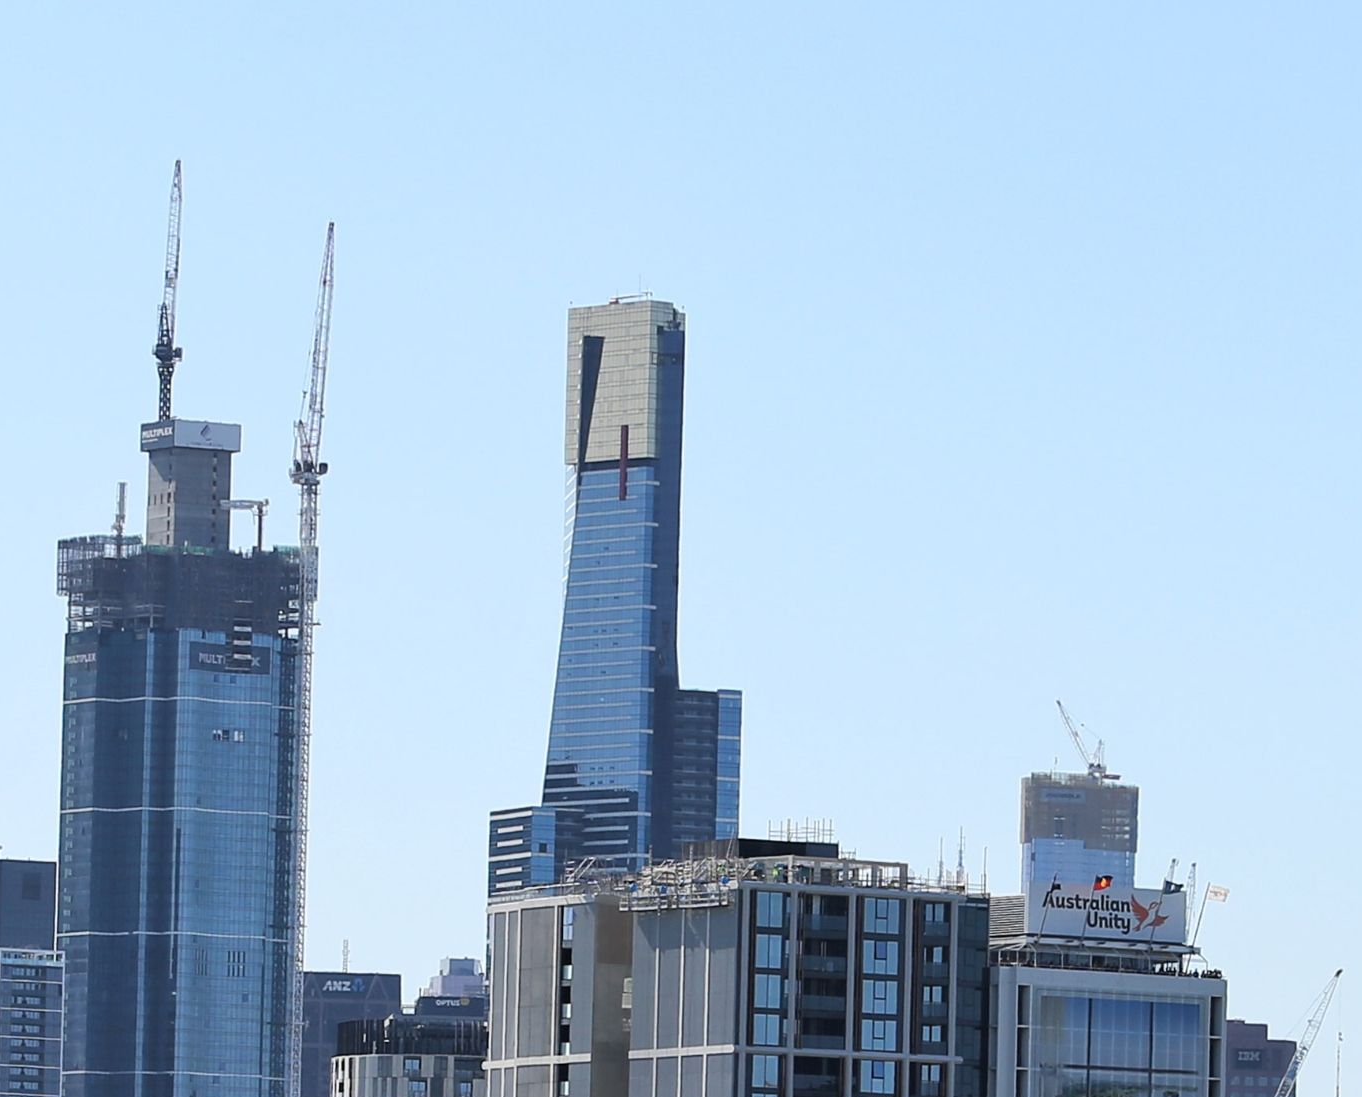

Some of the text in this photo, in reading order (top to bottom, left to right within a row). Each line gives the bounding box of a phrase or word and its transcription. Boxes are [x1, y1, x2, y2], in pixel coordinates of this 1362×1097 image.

[1042, 892, 1131, 913] Australian
[1087, 911, 1131, 934] Unity
[322, 980, 351, 992] ANZ
